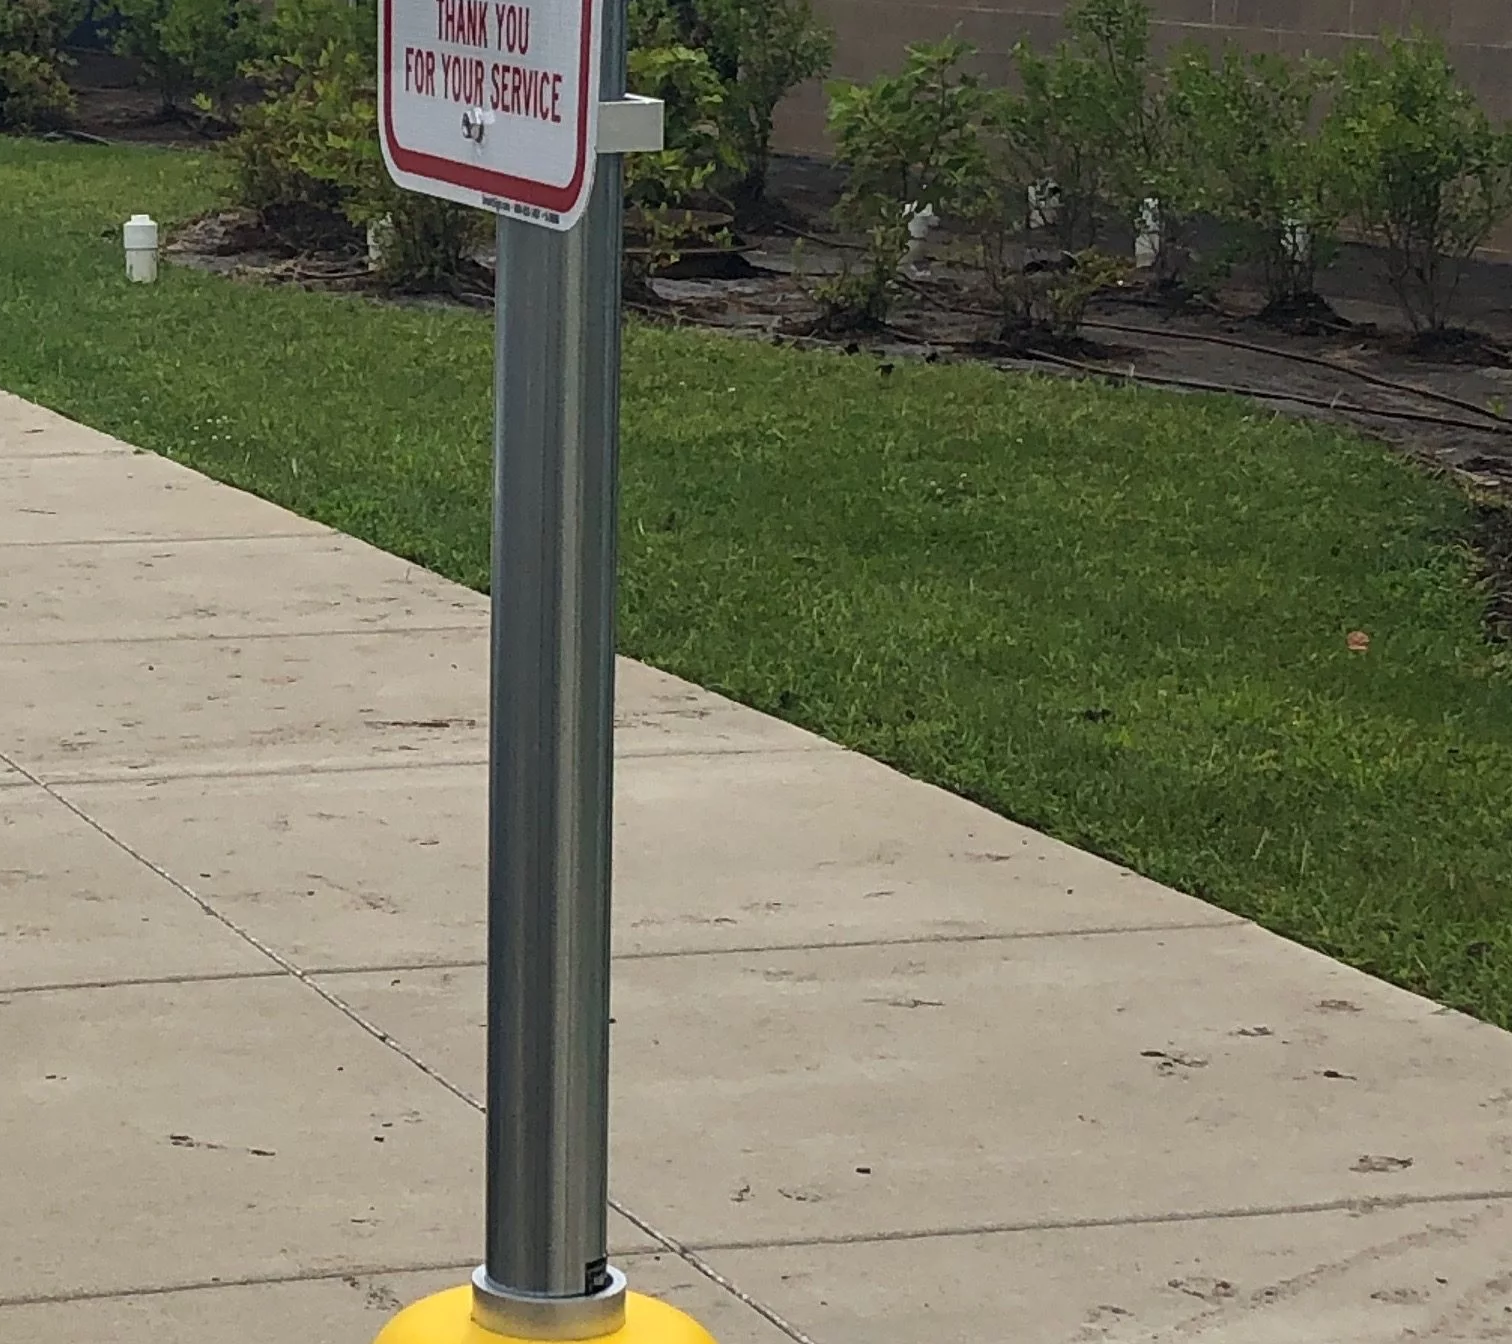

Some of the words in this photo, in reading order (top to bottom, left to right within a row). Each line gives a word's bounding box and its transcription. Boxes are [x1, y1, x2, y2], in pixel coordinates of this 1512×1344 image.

[495, 2, 530, 56] YOU
[405, 46, 436, 97] FOR
[441, 52, 485, 107] YOUR
[490, 62, 563, 124] SERVICE
